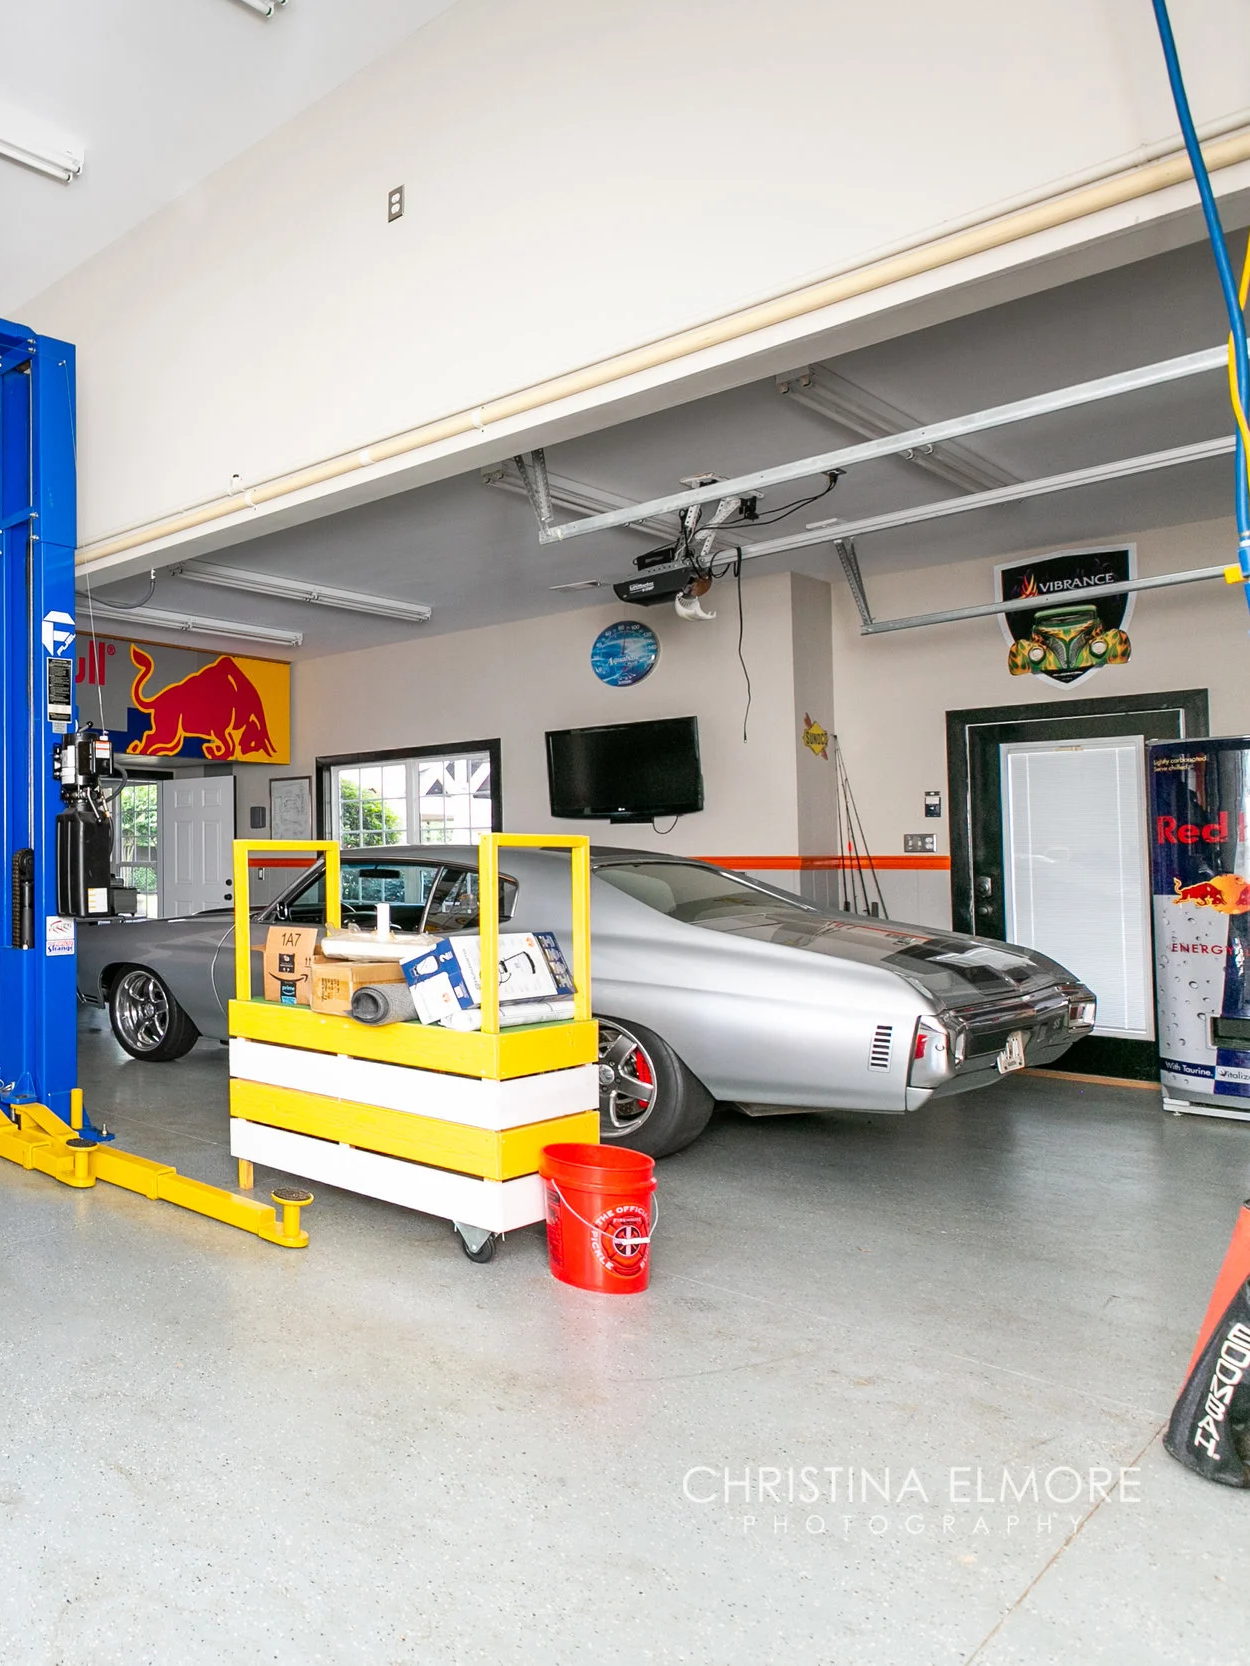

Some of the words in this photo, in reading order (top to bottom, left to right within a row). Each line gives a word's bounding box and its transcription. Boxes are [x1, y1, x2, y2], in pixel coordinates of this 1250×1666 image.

[1039, 572, 1115, 593] VIBRANCE
[1157, 810, 1229, 845] Red
[281, 932, 302, 947] 1A7
[1171, 942, 1234, 956] ENERGY
[1165, 1060, 1181, 1072] With
[595, 1208, 615, 1226] THE
[615, 1205, 648, 1219] OFFICI
[591, 1230, 615, 1271] PICKLE
